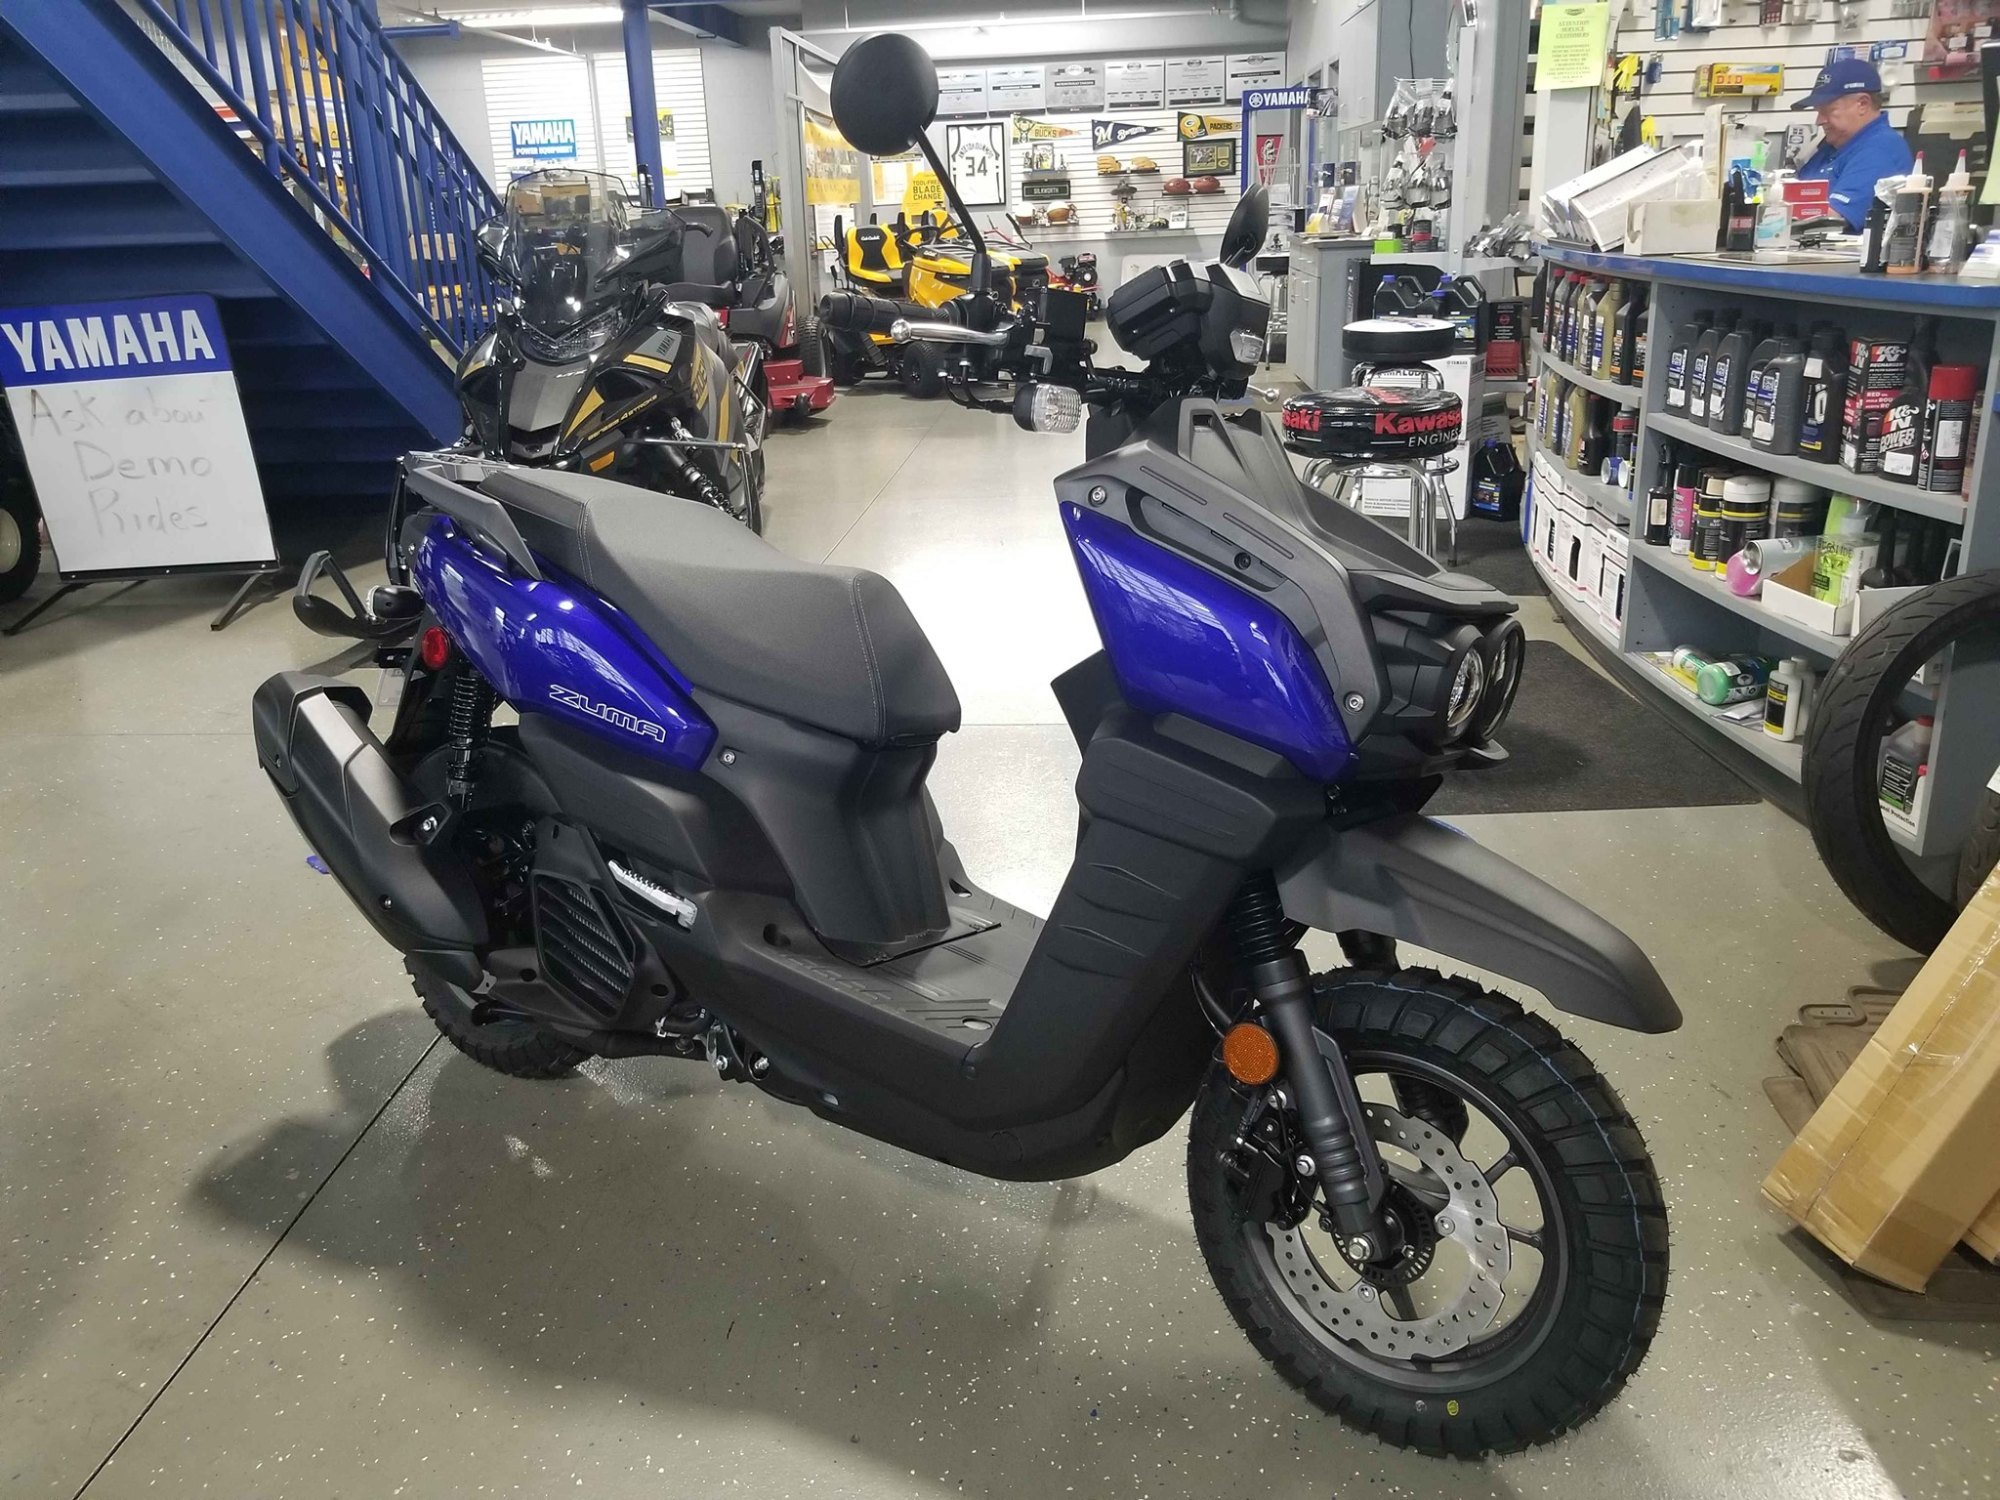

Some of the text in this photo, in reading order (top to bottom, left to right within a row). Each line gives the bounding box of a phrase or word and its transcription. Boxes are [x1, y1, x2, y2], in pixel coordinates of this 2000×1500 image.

[512, 122, 575, 146] YAMAHA
[1034, 129, 1057, 138] BUCKS
[1209, 122, 1233, 130] PACKERS
[965, 156, 988, 176] 34
[912, 185, 942, 194] BLADE
[1, 309, 216, 373] YAMAHA
[29, 389, 103, 437] Ask
[1886, 405, 1920, 433] K&N
[74, 440, 212, 482] Demo
[88, 487, 208, 538] Rides
[549, 684, 667, 743] ZUMA
